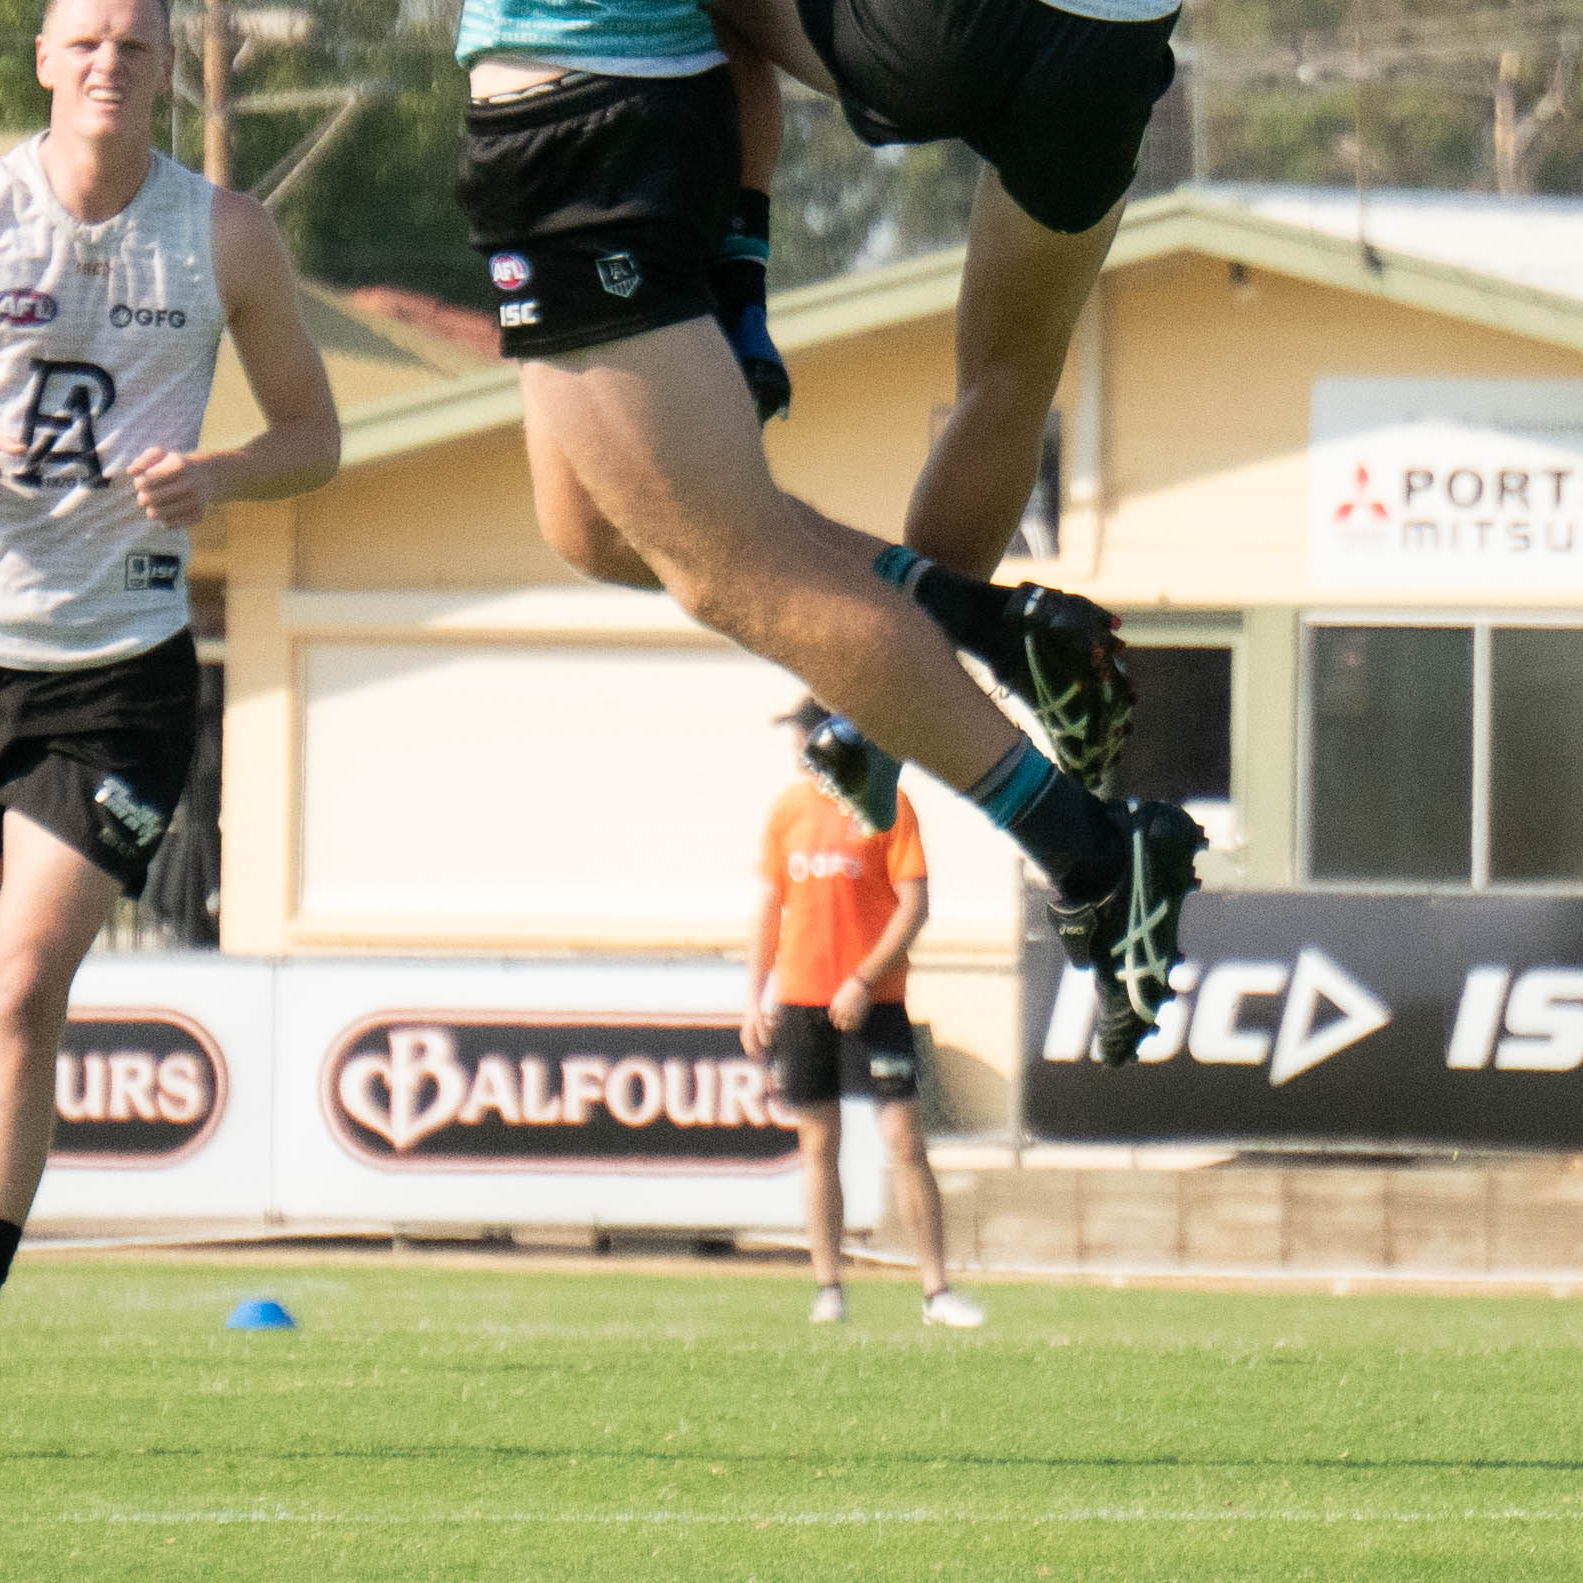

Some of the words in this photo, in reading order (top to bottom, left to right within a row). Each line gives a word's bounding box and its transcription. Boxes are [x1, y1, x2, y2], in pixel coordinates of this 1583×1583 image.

[493, 260, 525, 283] AFL
[134, 308, 187, 329] GFG
[499, 301, 538, 327] ISC
